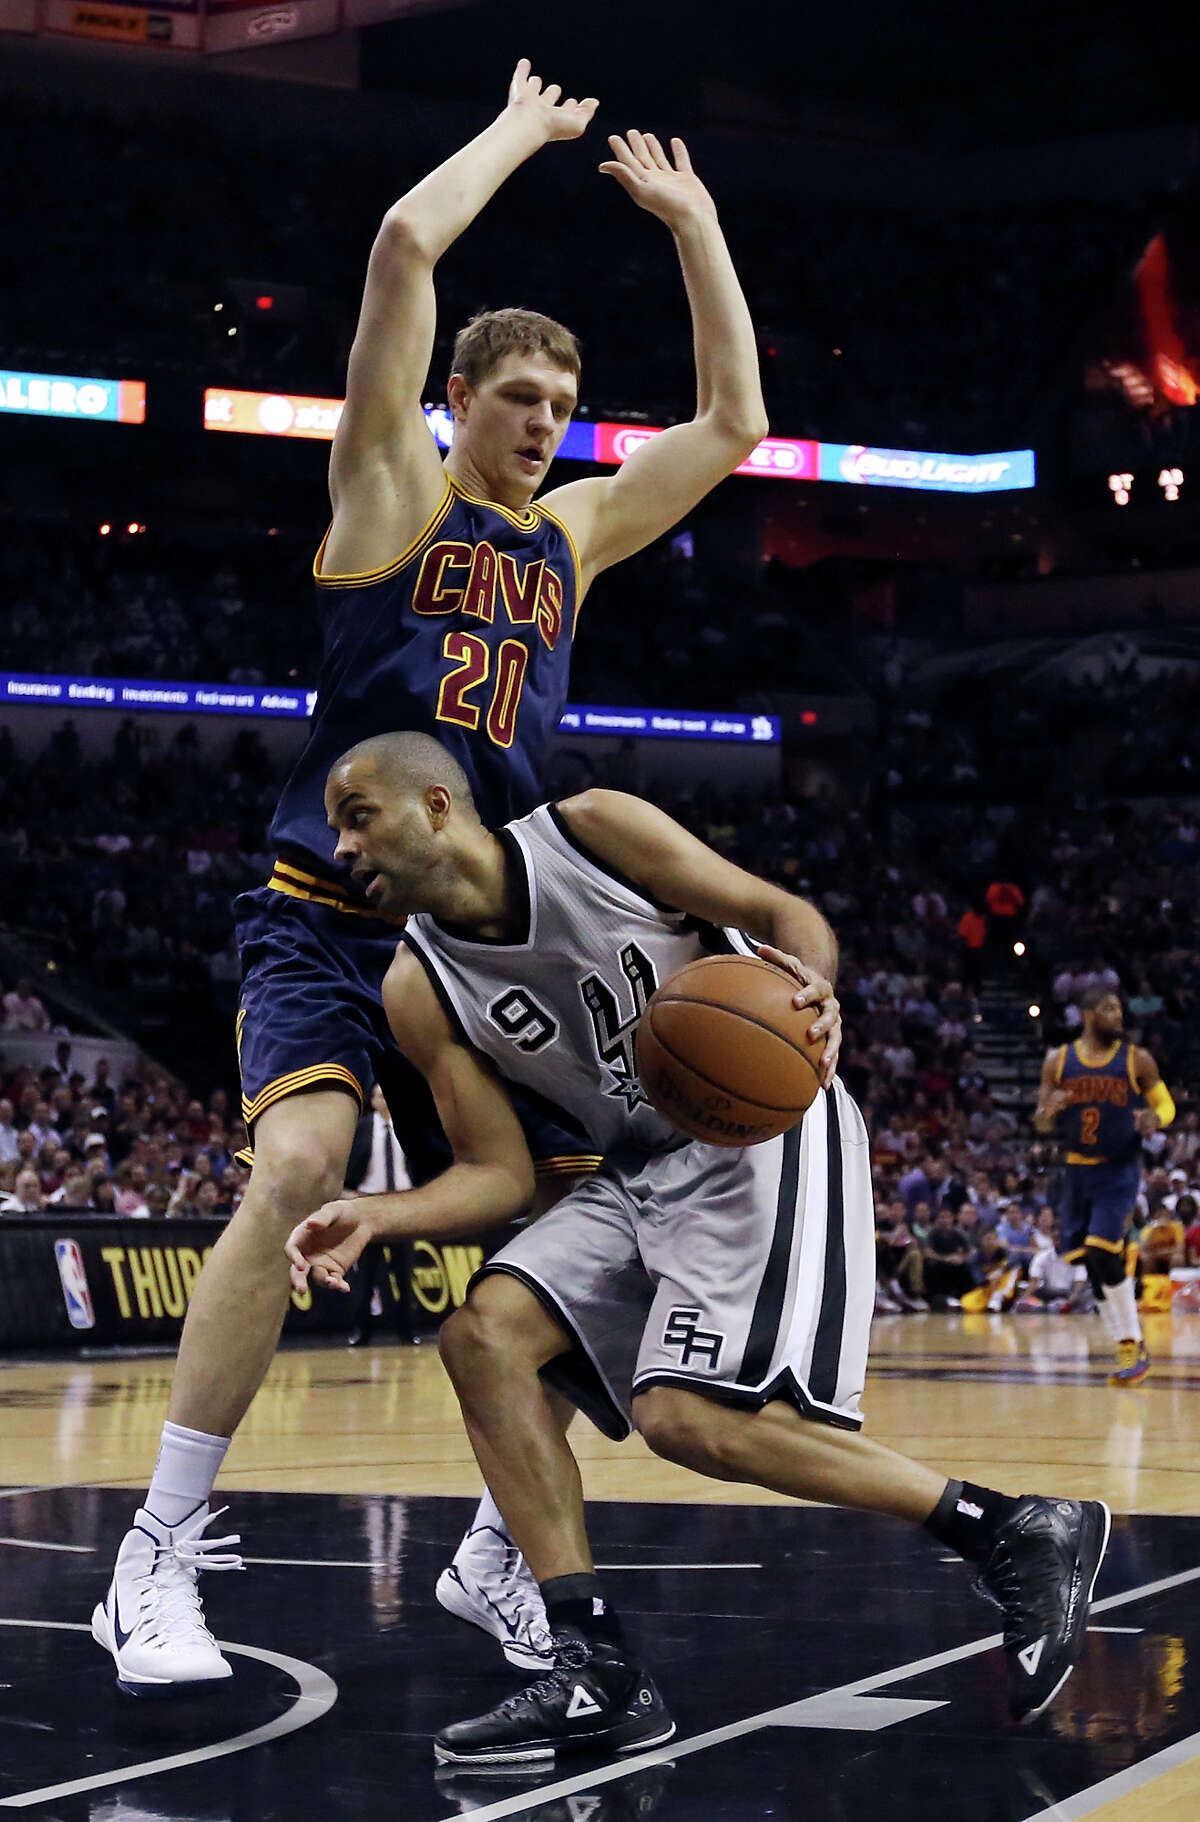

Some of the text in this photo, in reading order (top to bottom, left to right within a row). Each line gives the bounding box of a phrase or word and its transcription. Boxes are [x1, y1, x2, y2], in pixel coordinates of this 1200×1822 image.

[412, 540, 563, 651] CAVS
[435, 631, 528, 748] 20
[486, 985, 560, 1055] 9
[1081, 1107, 1100, 1145] 2
[101, 1246, 213, 1319] THUR
